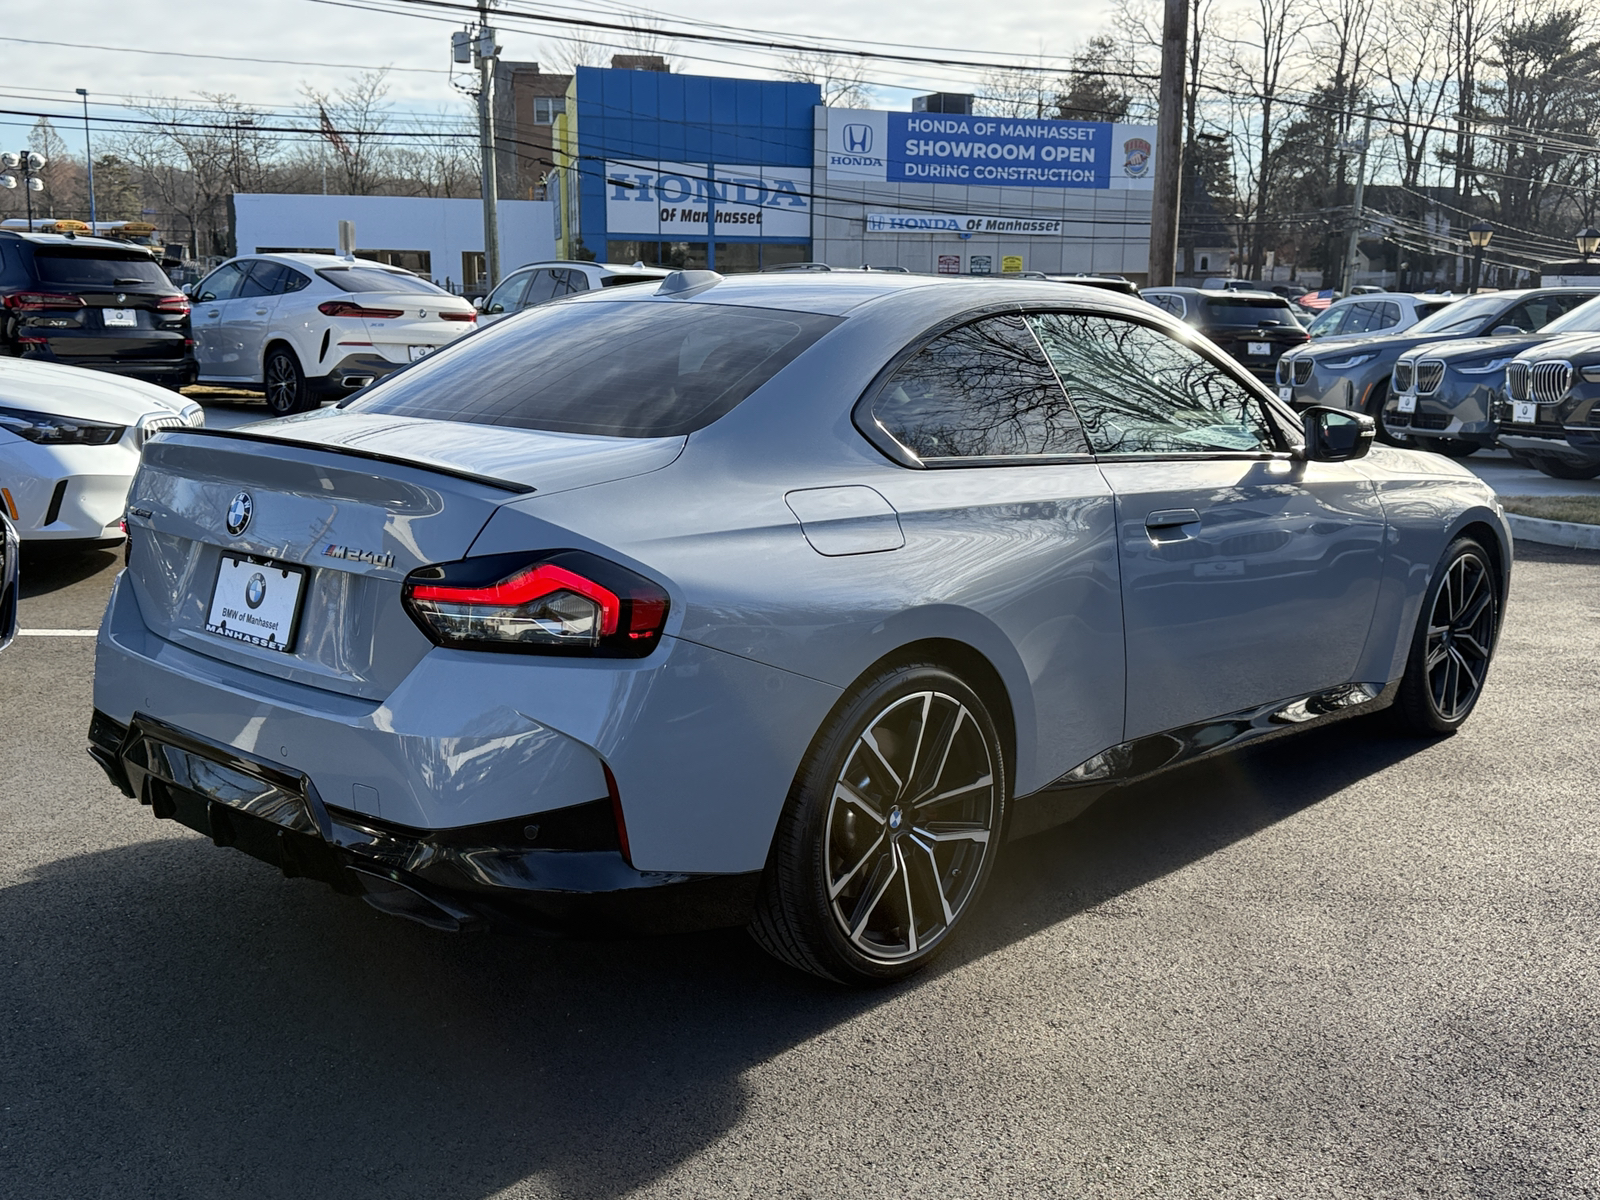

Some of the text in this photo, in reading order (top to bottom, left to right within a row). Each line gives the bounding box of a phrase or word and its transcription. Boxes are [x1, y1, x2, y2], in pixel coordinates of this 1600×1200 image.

[907, 118, 1096, 141] HONDA OF MANHASSET
[830, 156, 883, 167] HONDA
[905, 139, 1095, 163] SHOWROOM OPEN
[904, 163, 1095, 182] DURING CONSTRUCTION
[609, 173, 807, 207] HONDA
[889, 218, 961, 231] HONDA
[986, 219, 1060, 232] Manhasset
[330, 544, 396, 568] M240i
[222, 607, 279, 631] BMW of Manhasset
[205, 624, 286, 651] MANHASSET
